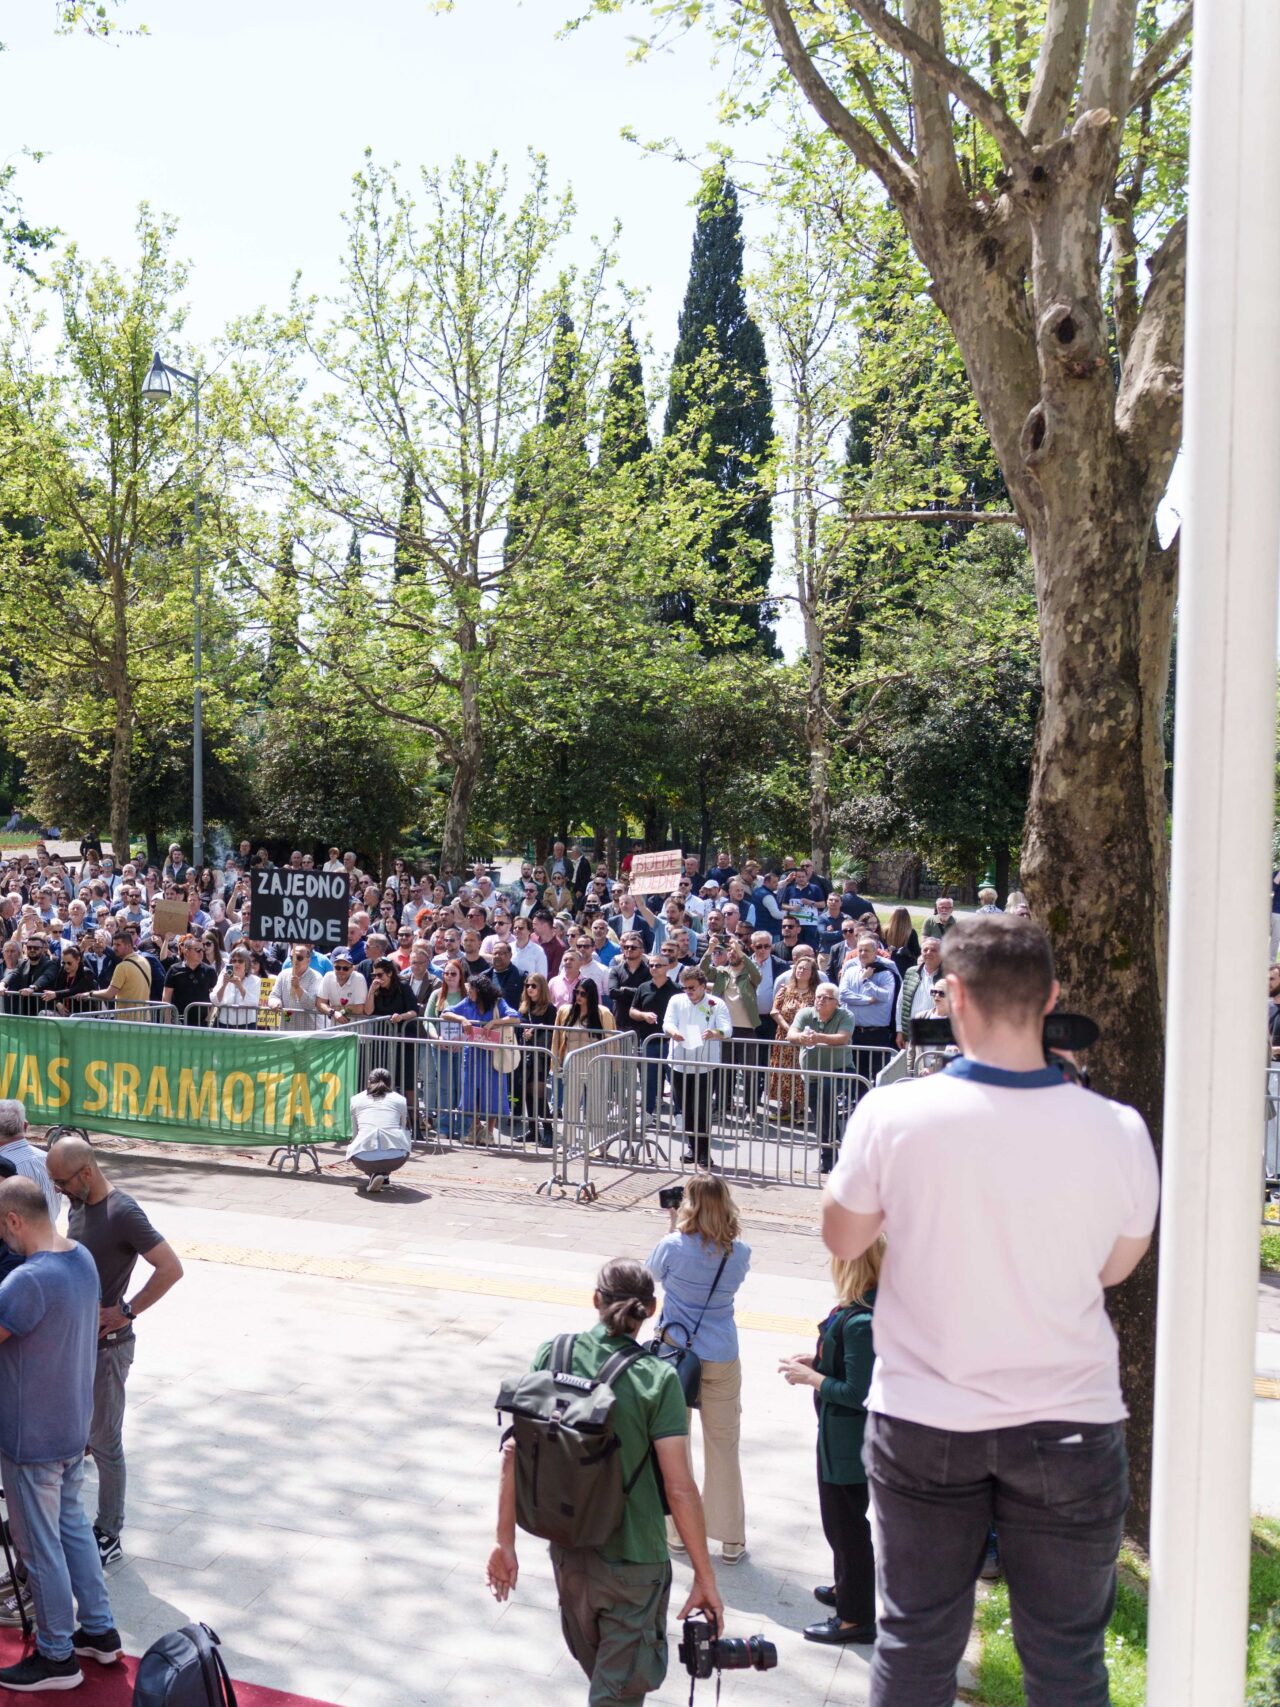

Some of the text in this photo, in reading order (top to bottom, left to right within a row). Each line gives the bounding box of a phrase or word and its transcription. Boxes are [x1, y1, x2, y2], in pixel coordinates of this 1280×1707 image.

[257, 872, 346, 899] ZAJEDNO
[282, 897, 308, 919] DO
[260, 916, 342, 942] PRAVDE
[83, 1060, 342, 1129] SRAMOTA?
